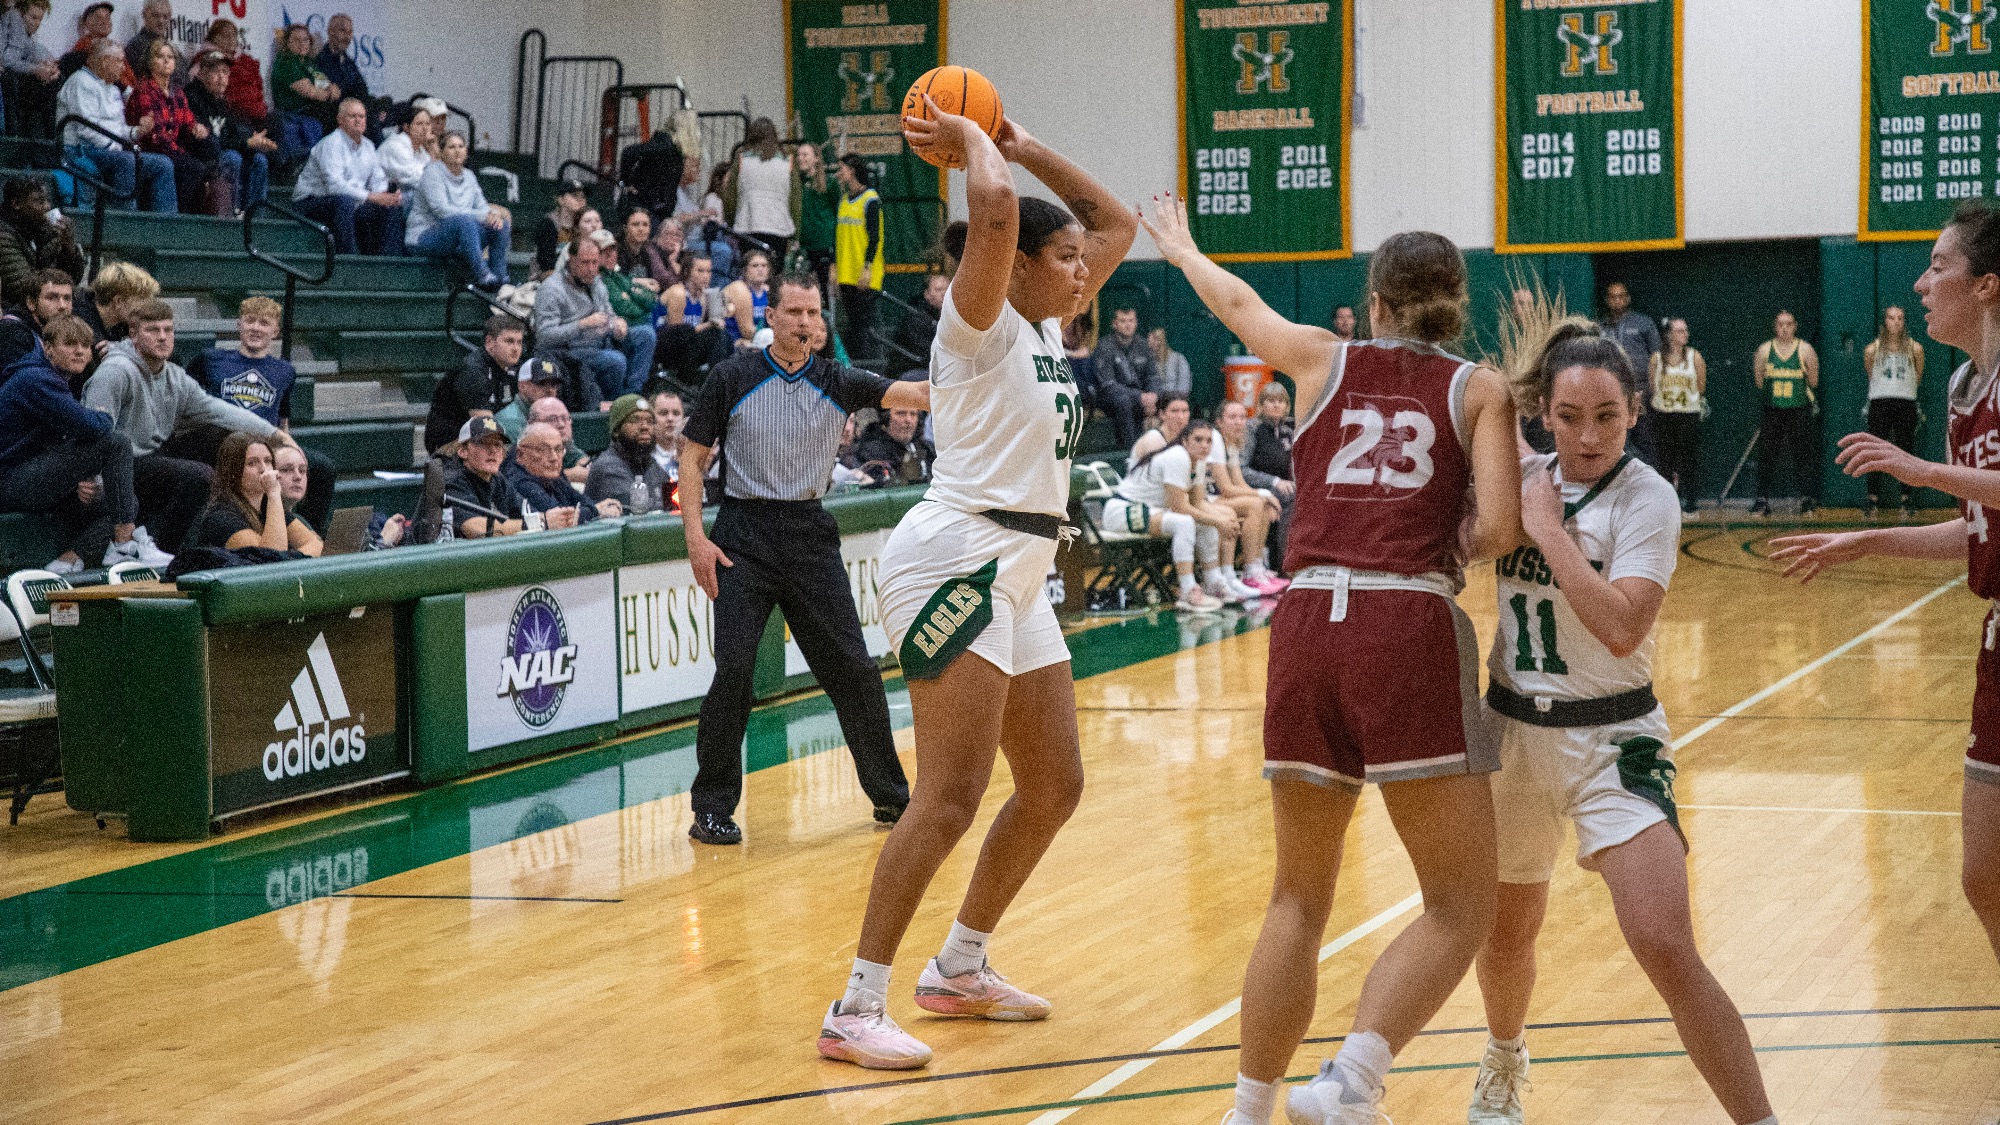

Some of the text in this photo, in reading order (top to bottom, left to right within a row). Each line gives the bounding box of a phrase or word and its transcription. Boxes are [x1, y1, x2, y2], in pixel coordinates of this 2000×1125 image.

[1198, 2, 1329, 28] TOURNAMENT
[1536, 90, 1644, 116] FOOTBALL
[1213, 107, 1314, 132] BASEBALL
[1880, 116, 1925, 134] 2009
[1938, 113, 1981, 131] 2010
[1522, 132, 1575, 155] 2014
[1606, 128, 1661, 151] 2016
[1881, 138, 1924, 156] 2012
[1197, 148, 1251, 169] 2009
[1281, 144, 1327, 166] 2011
[1606, 153, 1661, 176] 2018
[1276, 167, 1332, 190] 2022
[1522, 156, 1575, 180] 2017
[1199, 171, 1249, 192] 2021
[1881, 184, 1923, 202] 2021
[1936, 181, 1983, 199] 2022
[1197, 194, 1251, 215] 2023
[224, 384, 275, 402] NORTHEAST
[1326, 408, 1436, 489] 23
[1957, 428, 2000, 469] TES
[1496, 546, 1560, 589] USS
[509, 589, 567, 648] NORTH ATLANTIC
[913, 583, 983, 659] EAGLES
[1509, 593, 1568, 675] 11
[497, 645, 577, 696] NAC
[516, 687, 564, 725] CONFERENCE
[262, 719, 366, 782] adidas
